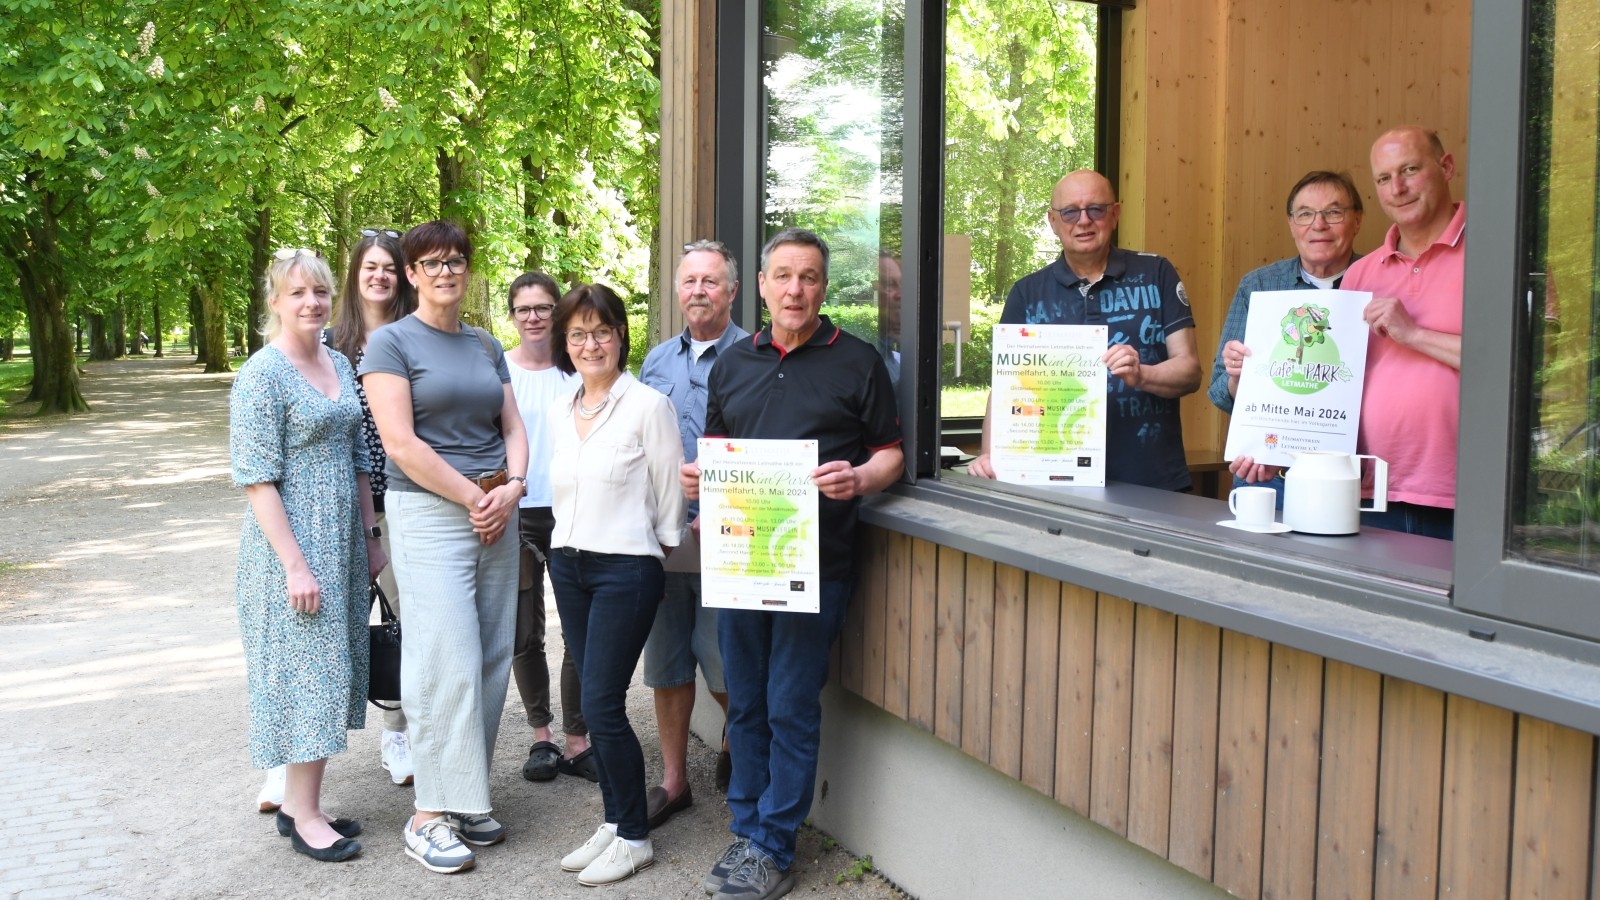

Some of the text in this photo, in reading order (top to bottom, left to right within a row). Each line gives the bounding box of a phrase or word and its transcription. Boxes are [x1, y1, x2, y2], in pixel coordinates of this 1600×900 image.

[1100, 284, 1161, 313] DAVID
[996, 353, 1048, 366] MUSIK
[1066, 353, 1103, 368] Park
[996, 369, 1048, 377] Himmelfahrt,
[1306, 363, 1340, 382] PARK
[1282, 381, 1318, 389] LETMATHE
[1245, 403, 1346, 420] ab Mitte Mai 2024
[703, 469, 755, 484] MUSIK
[703, 486, 757, 495] Himmelfahrt,
